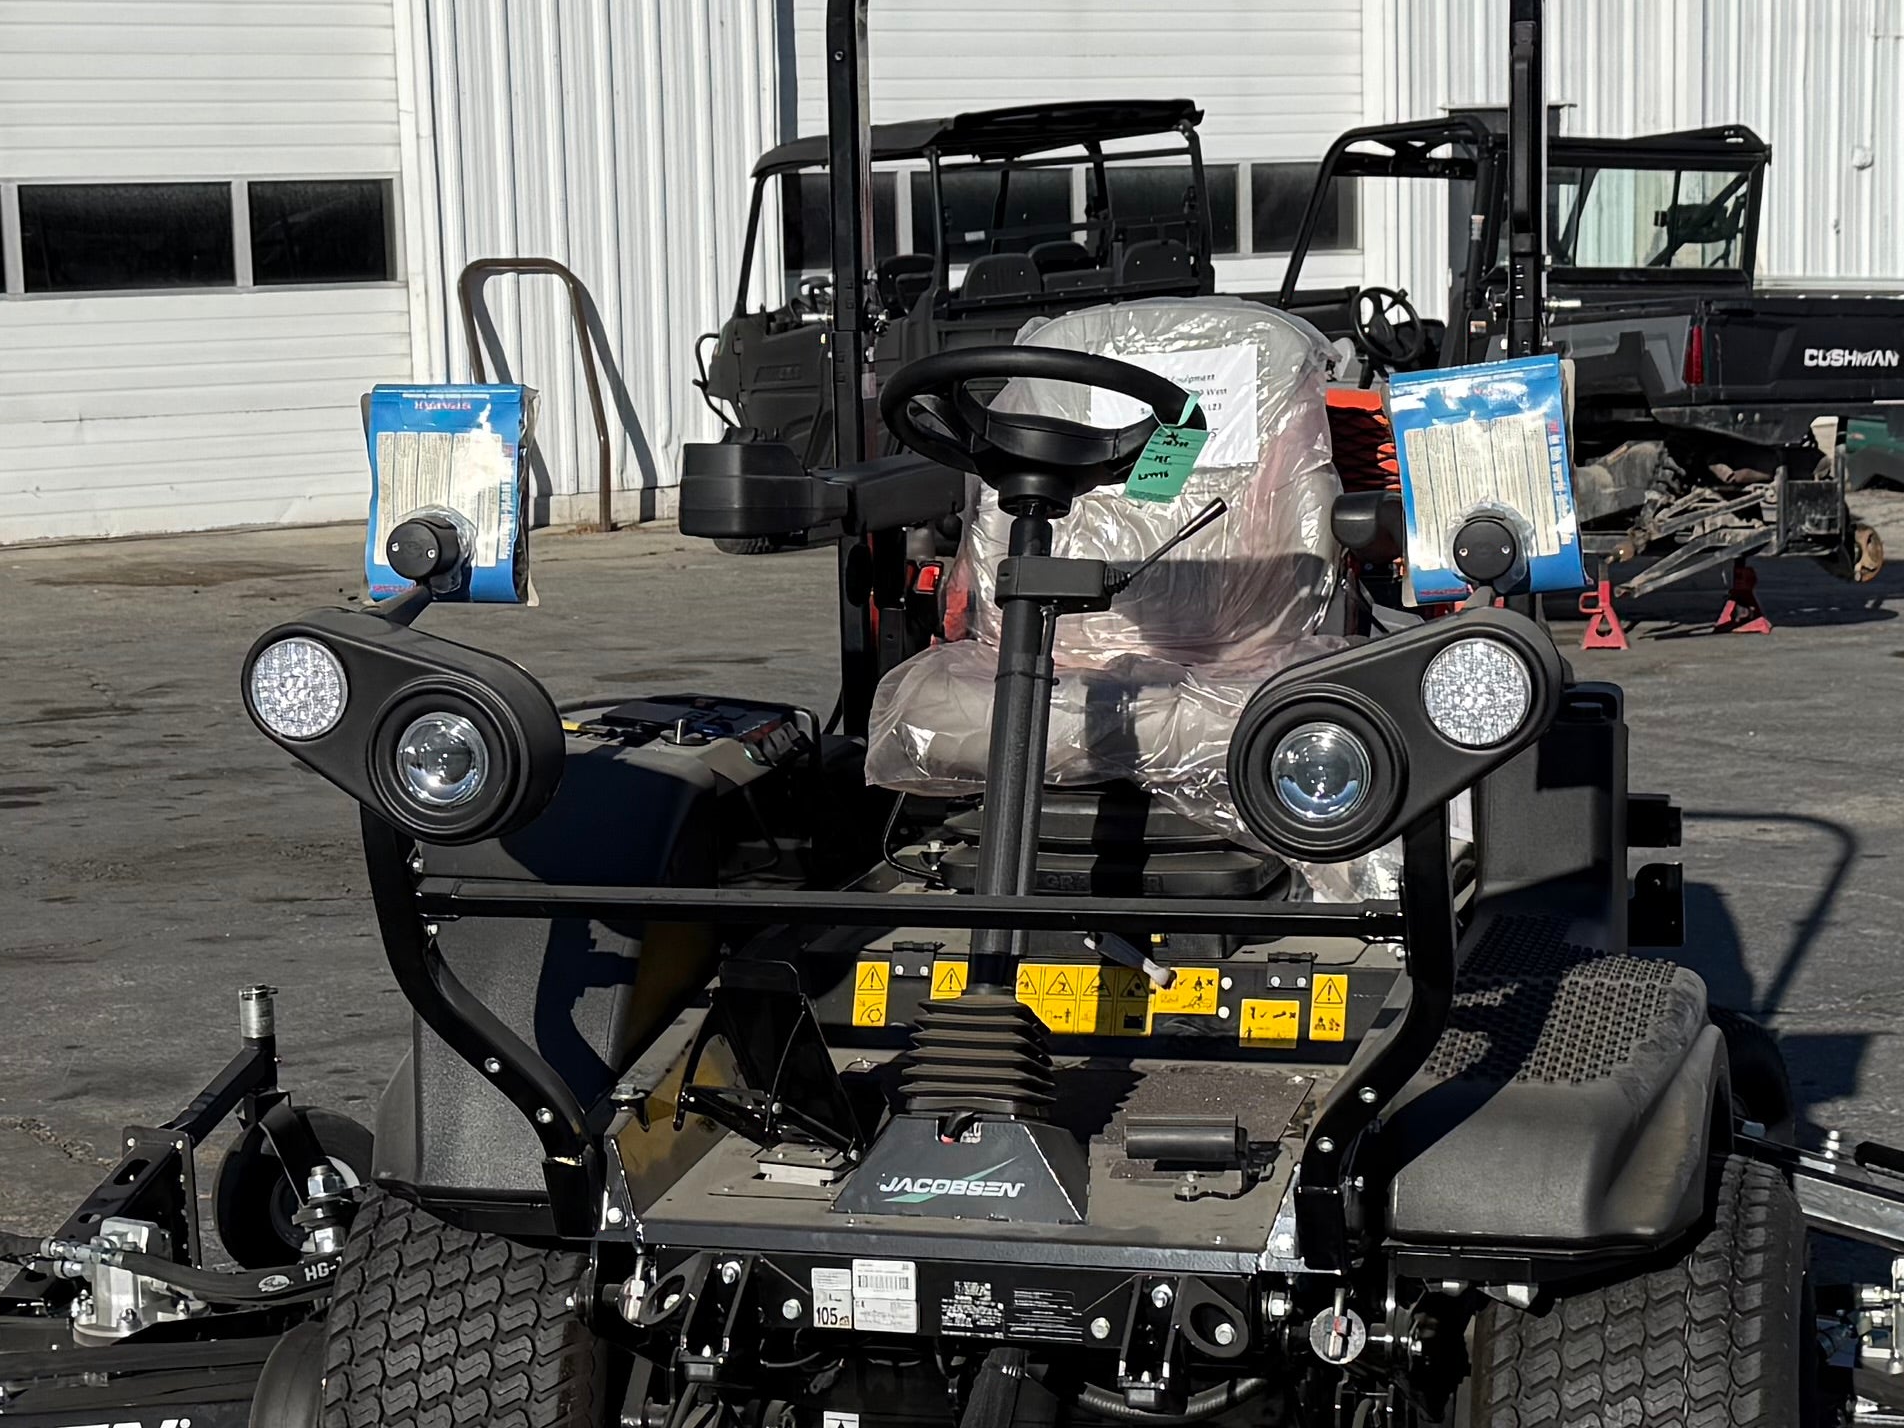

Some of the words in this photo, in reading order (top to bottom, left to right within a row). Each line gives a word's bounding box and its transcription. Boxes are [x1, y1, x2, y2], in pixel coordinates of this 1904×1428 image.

[1804, 348, 1899, 368] CUSHMAN
[880, 1176, 1025, 1198] JACOBSEN
[816, 1306, 838, 1325] 105
